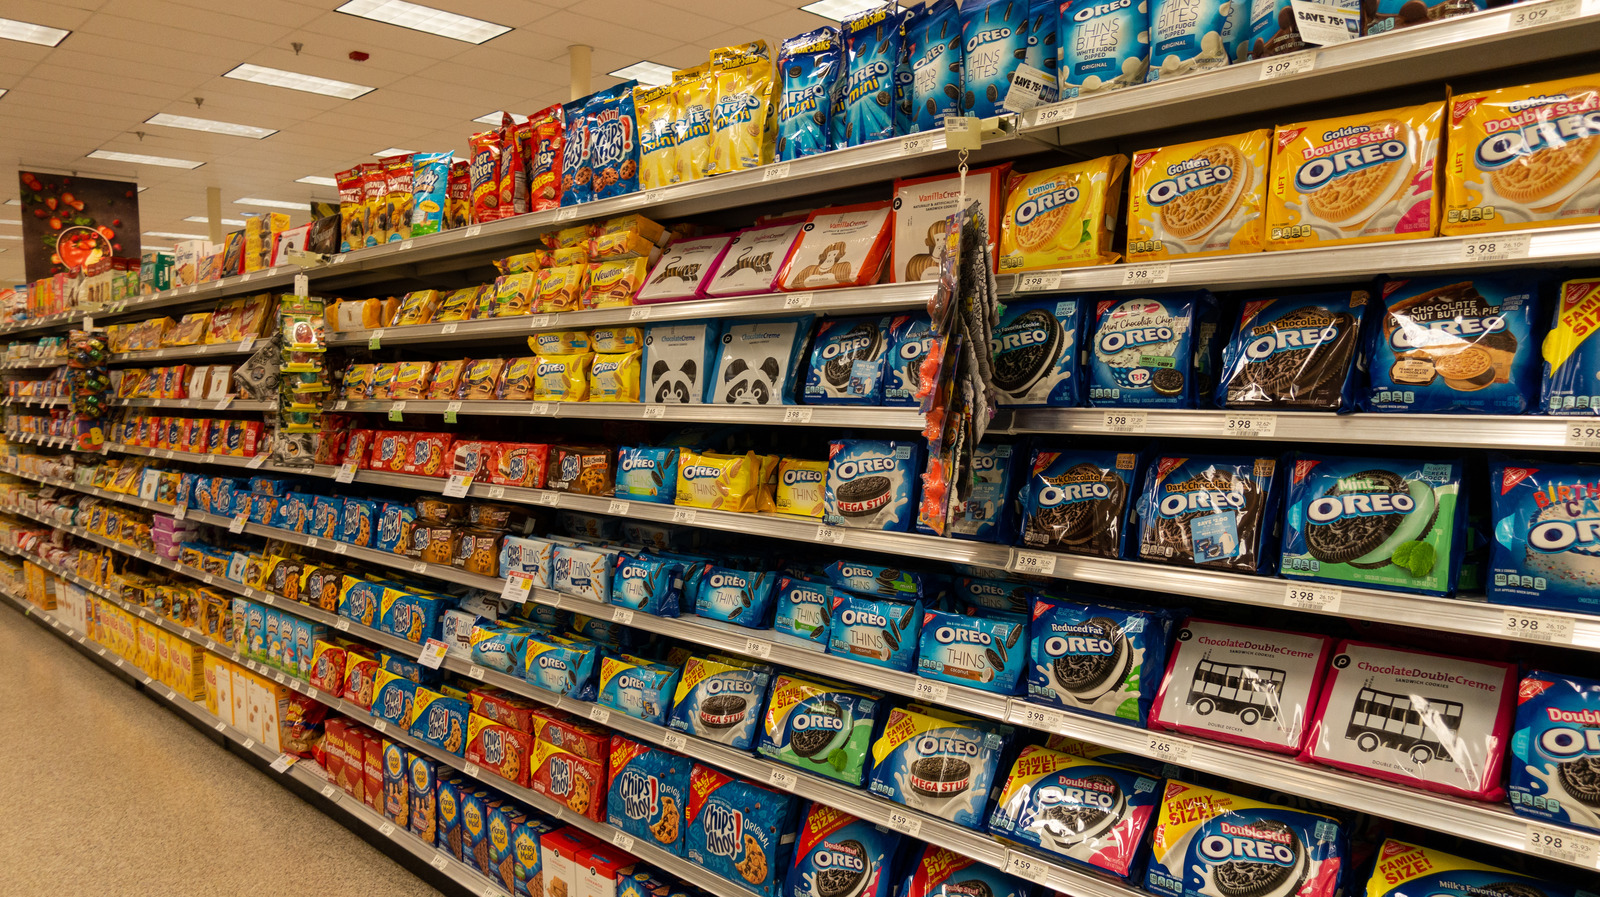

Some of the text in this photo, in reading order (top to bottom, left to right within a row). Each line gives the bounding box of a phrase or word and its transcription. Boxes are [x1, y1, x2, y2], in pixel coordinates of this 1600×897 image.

[1073, 0, 1131, 22] OREO
[1157, 6, 1199, 31] BITES
[1298, 11, 1326, 24] SAVE
[1076, 18, 1120, 36] THINS
[1158, 22, 1197, 36] WHITE FUDGE
[1164, 29, 1186, 40] DIPPED
[966, 27, 1011, 53] OREO
[1076, 31, 1119, 51] BITES
[1161, 40, 1187, 52] ORIGINAL
[912, 43, 946, 71] OREO
[967, 49, 1000, 68] THINS
[1076, 46, 1117, 57] WHITE FUDGE
[1084, 51, 1107, 61] DIPPED
[968, 63, 998, 83] BITES
[1081, 62, 1108, 71] ORIGINAL
[847, 61, 889, 94] OREO
[1013, 75, 1032, 89] SAVE
[848, 76, 880, 105] mini
[1484, 96, 1600, 134] Double Stuf
[1302, 127, 1396, 160] Double Stuf
[1322, 126, 1370, 143] Golden
[1166, 158, 1211, 177] Golden
[1296, 140, 1406, 188] OREO
[1455, 152, 1465, 174] LIFT
[1027, 181, 1056, 197] Lemon
[1148, 165, 1232, 206] OREO
[1276, 175, 1286, 195] LIFT
[1016, 187, 1079, 225] OREO
[1133, 194, 1141, 213] LIFT
[1411, 300, 1477, 314] CHOCOLATE
[1436, 305, 1500, 319] BUTTER PIE
[1001, 323, 1021, 333] Favorite
[1102, 315, 1174, 333] Mint Chocolate Chip
[1252, 317, 1329, 336] Dark Chocolate
[538, 336, 560, 346] OREO
[661, 334, 696, 342] ChocolateCreme
[1101, 328, 1172, 353] OREO
[1247, 327, 1338, 359] OREO
[822, 337, 870, 360] OREO
[537, 363, 566, 377] OREO
[622, 458, 655, 472] OREO
[682, 465, 720, 480] OREO
[837, 458, 895, 480] OREO
[783, 470, 823, 486] OREO
[1063, 472, 1100, 483] Chocolate
[1165, 481, 1186, 493] Dark
[1338, 478, 1374, 492] Mint
[692, 482, 717, 497] THINS
[791, 487, 819, 503] THINS
[1039, 483, 1109, 507] OREO
[837, 491, 892, 513] MEGA STUF
[1160, 491, 1246, 518] OREO
[1308, 494, 1415, 524] OREO
[572, 560, 591, 578] THINS
[622, 567, 648, 579] OREO
[842, 566, 874, 578] OREO
[709, 575, 746, 589] OREO
[848, 578, 870, 592] THINS
[899, 582, 914, 591] mint
[970, 584, 1004, 596] OREO
[716, 591, 741, 606] THINS
[790, 589, 825, 604] OREO
[841, 609, 887, 628] OREO
[850, 629, 883, 649] THINS
[935, 626, 992, 646] OREO
[1051, 623, 1104, 636] Reduced Fat
[479, 641, 506, 653] OREO
[1045, 637, 1113, 656] OREO
[1198, 635, 1314, 660] ChocolateDoubleCreme
[1229, 648, 1275, 659] SANDWICH COOKIES
[539, 656, 567, 670] OREO
[946, 648, 986, 669] THINS
[684, 662, 704, 683] FAMILY
[686, 669, 707, 690] SIZE!
[949, 667, 969, 676] coconut
[1357, 661, 1497, 692] ChocolateDoubleCreme
[618, 675, 645, 690] OREO
[707, 679, 752, 693] OREO
[1394, 677, 1450, 689] SANDWICH COOKIES
[700, 711, 745, 725] MEGA STUF
[792, 712, 844, 732] OREO
[886, 716, 915, 739] FAMILY
[1207, 721, 1244, 732] DOUBLE DECKER
[483, 727, 501, 748] Chips
[889, 723, 917, 748] SIZE!
[918, 737, 979, 756] OREO
[550, 756, 569, 779] Chips
[574, 760, 592, 781] CHEWY
[1017, 761, 1057, 778] SIZE!
[1018, 754, 1057, 769] FAMILY
[1371, 758, 1392, 768] DOUBLE
[620, 772, 651, 798] Chips
[911, 775, 970, 792] MEGA STUF
[1058, 775, 1115, 794] Double Stuf
[659, 782, 682, 809] ORIGINAL
[704, 804, 735, 832] Chips
[1168, 803, 1217, 826] SIZE!
[744, 818, 769, 849] ORIGINAL
[1221, 822, 1292, 845] Double Stuf
[823, 840, 858, 856] Double Stuf
[1201, 835, 1294, 863] OREO
[814, 851, 864, 870] OREO
[1379, 850, 1427, 875] FAMILY
[1384, 858, 1434, 886] SIZE!
[1439, 880, 1499, 897] Milk's Favorite
